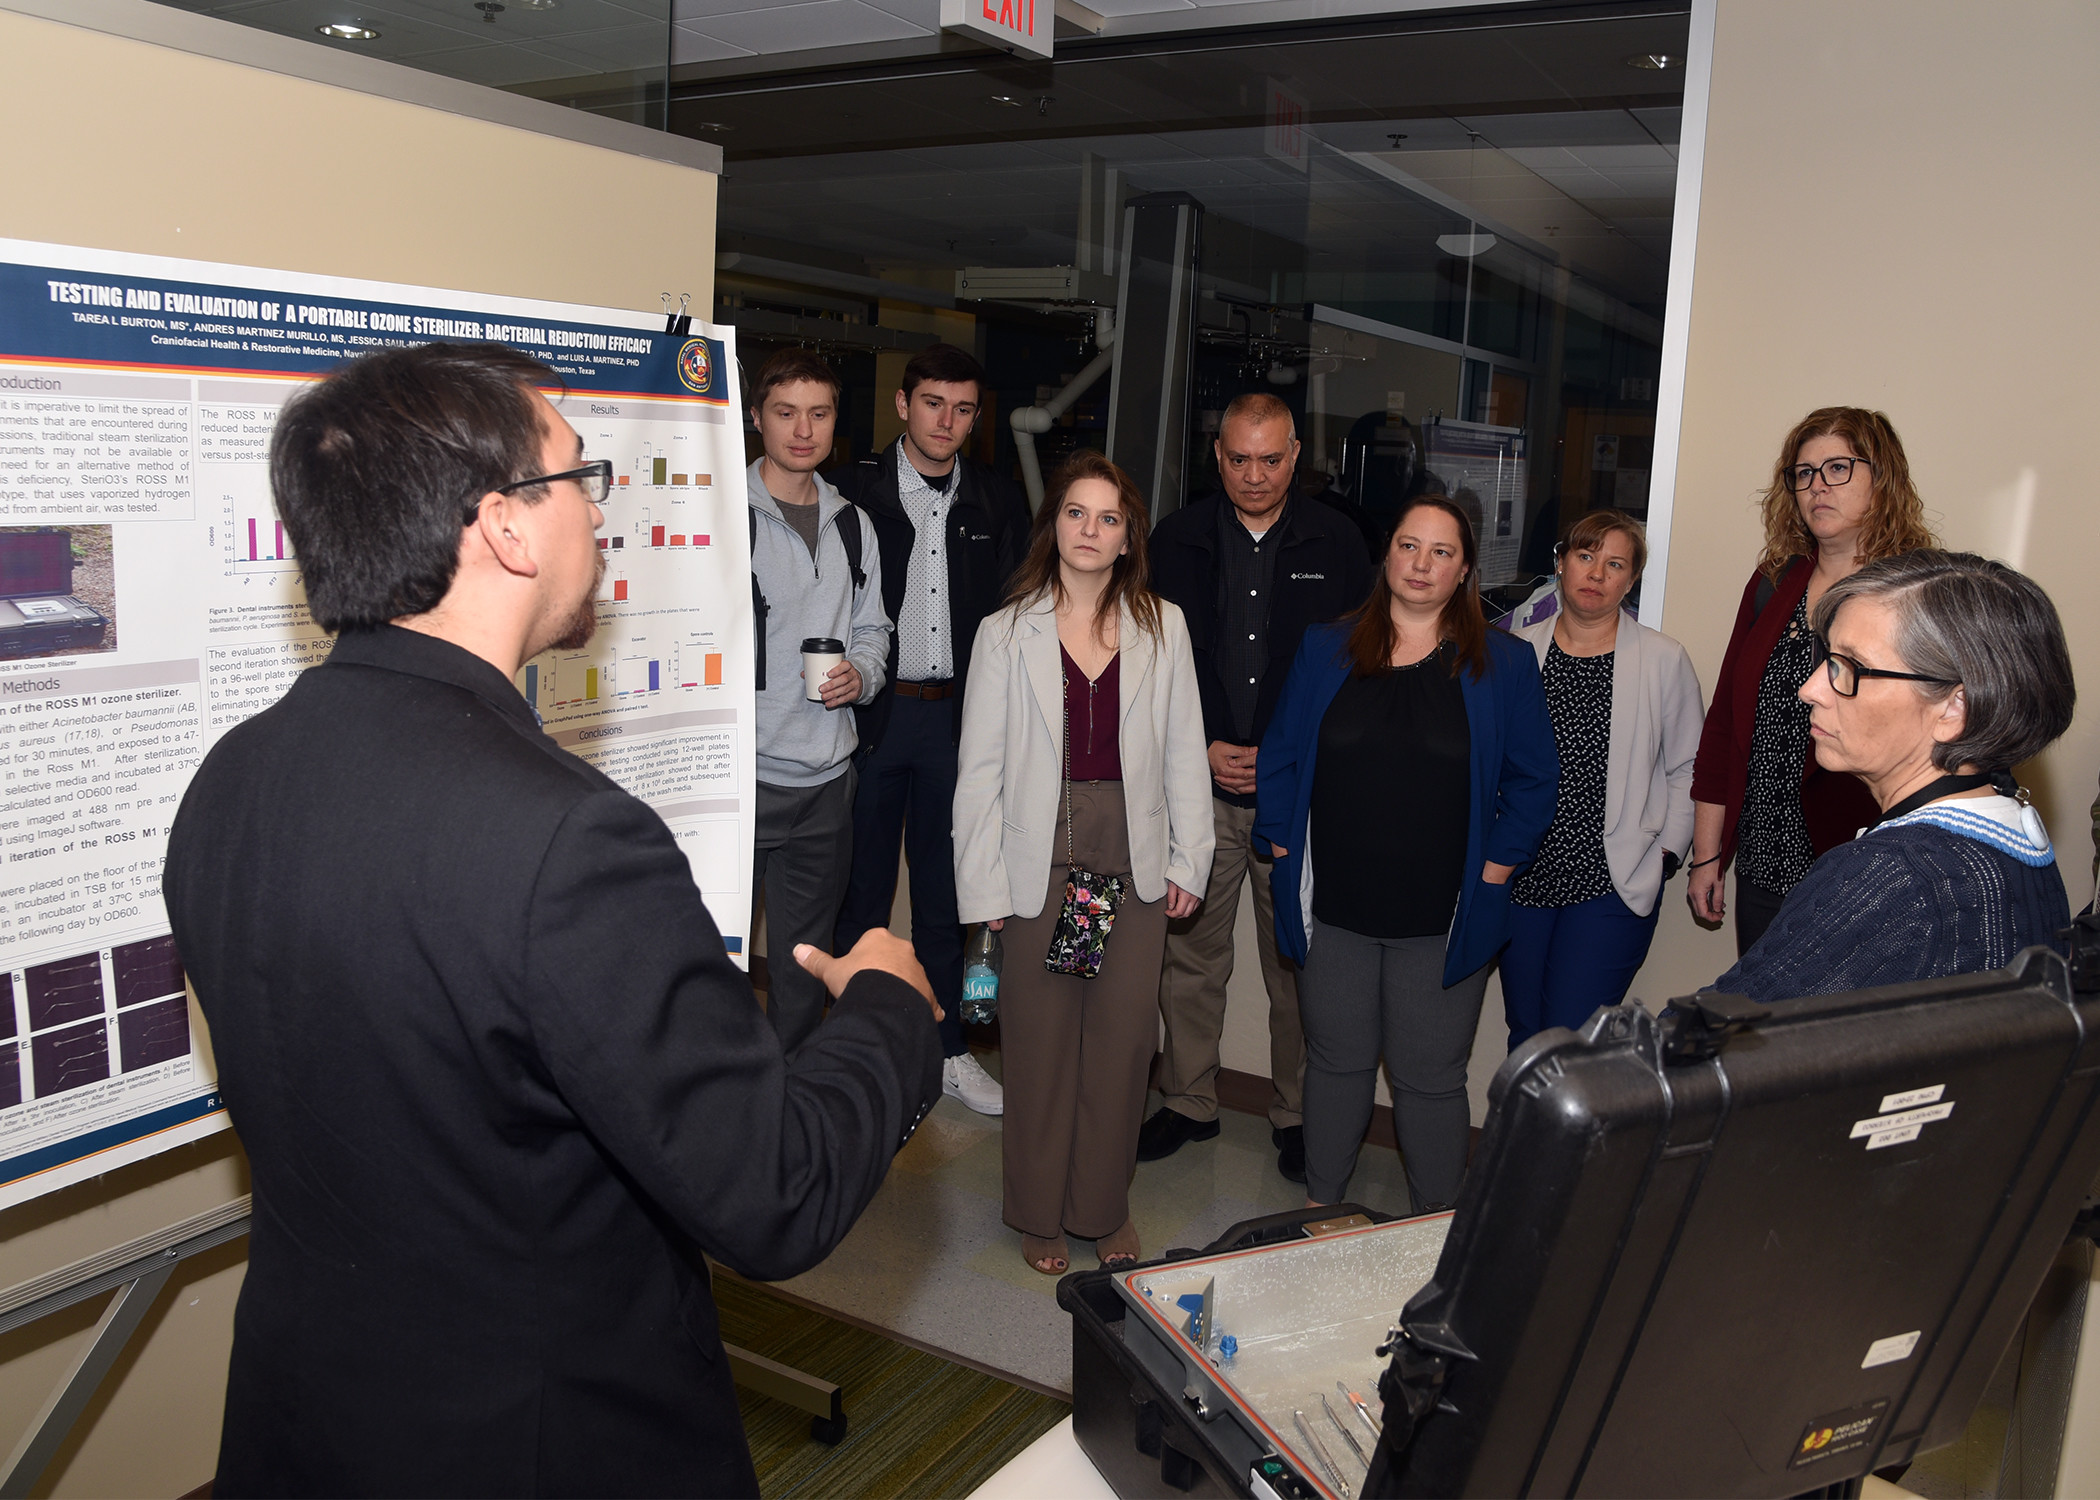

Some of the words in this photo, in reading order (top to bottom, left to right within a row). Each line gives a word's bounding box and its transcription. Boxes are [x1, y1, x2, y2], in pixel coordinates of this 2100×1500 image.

[47, 280, 123, 308] TESTING
[125, 288, 161, 311] AND
[164, 292, 258, 320] EVALUATION
[261, 301, 280, 322] OF
[285, 304, 297, 323] A
[298, 305, 368, 329] PORTABLE
[370, 312, 412, 333] OZONE
[413, 316, 484, 340] STERILIZER:
[485, 323, 547, 345] BACTERIAL
[548, 329, 607, 350] REDUCTION
[608, 335, 652, 354] EFFICACY
[72, 312, 110, 325] TAREA
[111, 316, 119, 326] L
[120, 316, 168, 331] BURTON,
[193, 322, 235, 335] ANDRES
[236, 326, 285, 339] MARTINEZ
[286, 330, 329, 343] MURILLO,
[331, 334, 347, 344] MS,
[348, 335, 384, 346] JESSICA
[151, 334, 209, 348] Craniofacial
[210, 339, 240, 350] Health
[242, 341, 250, 351] &
[251, 342, 302, 355] Restorative
[302, 346, 343, 358] Medicine,
[538, 351, 554, 361] PHD,
[570, 354, 585, 362] LUIS
[593, 356, 626, 366] MARTINEZ,
[626, 358, 640, 367] PHD
[578, 366, 596, 375] Texas
[0, 375, 61, 391] oduction
[0, 400, 8, 410] it
[11, 402, 21, 410] is
[24, 403, 81, 413] imperative
[84, 404, 95, 413] to
[98, 403, 120, 414] limit
[122, 404, 139, 415] the
[141, 406, 175, 417] spread
[178, 406, 188, 416] of
[201, 409, 219, 419] The
[227, 410, 256, 420] ROSS
[591, 404, 620, 415] Results
[201, 423, 238, 433] reduced
[42, 431, 94, 442] traditional
[98, 433, 130, 442] steam
[134, 434, 188, 444] sterilization
[0, 460, 28, 470] need
[35, 459, 50, 470] for
[56, 462, 70, 470] an
[77, 460, 131, 471] alternative
[137, 461, 174, 471] method
[180, 461, 190, 471] of
[17, 474, 72, 487] deficiency,
[81, 474, 128, 485] SteriO3's
[136, 474, 168, 485] ROSS
[175, 475, 189, 484] M1
[33, 489, 55, 499] that
[60, 491, 86, 499] uses
[90, 489, 140, 501] vaporized
[145, 489, 191, 501] hydrogen
[12, 504, 37, 514] from
[40, 504, 83, 514] ambient
[85, 505, 101, 513] air,
[103, 505, 125, 513] was
[127, 503, 160, 513] tested.
[208, 650, 226, 659] The
[231, 646, 276, 658] evaluation
[280, 643, 290, 653] of
[293, 642, 308, 652] the
[209, 661, 242, 673] second
[244, 659, 279, 669] iteration
[281, 654, 314, 666] showed
[2, 677, 61, 694] Methods
[10, 704, 22, 715] of
[24, 703, 42, 713] the
[46, 698, 79, 710] ROSS
[82, 696, 97, 706] M1
[101, 694, 133, 705] ozone
[136, 689, 182, 701] sterilizer.
[19, 721, 49, 732] either
[51, 712, 123, 728] Acinetobacter
[125, 707, 175, 719] baumannii
[177, 702, 197, 715] (AB,
[579, 726, 623, 740] Conclusions
[5, 782, 52, 796] selective
[56, 776, 88, 788] media
[91, 771, 110, 783] and
[114, 764, 161, 779] incubated
[165, 762, 175, 772] at
[6, 833, 35, 845] using
[38, 824, 76, 839] ImageJ
[78, 818, 124, 832] software.
[9, 847, 56, 862] iteration
[63, 842, 74, 853] of
[80, 839, 98, 849] the
[105, 831, 136, 845] ROSS
[142, 827, 156, 838] M1
[18, 924, 64, 941] following
[67, 920, 86, 930] day
[88, 916, 101, 926] by
[103, 906, 141, 922] OD600.
[964, 980, 995, 999] ASANI
